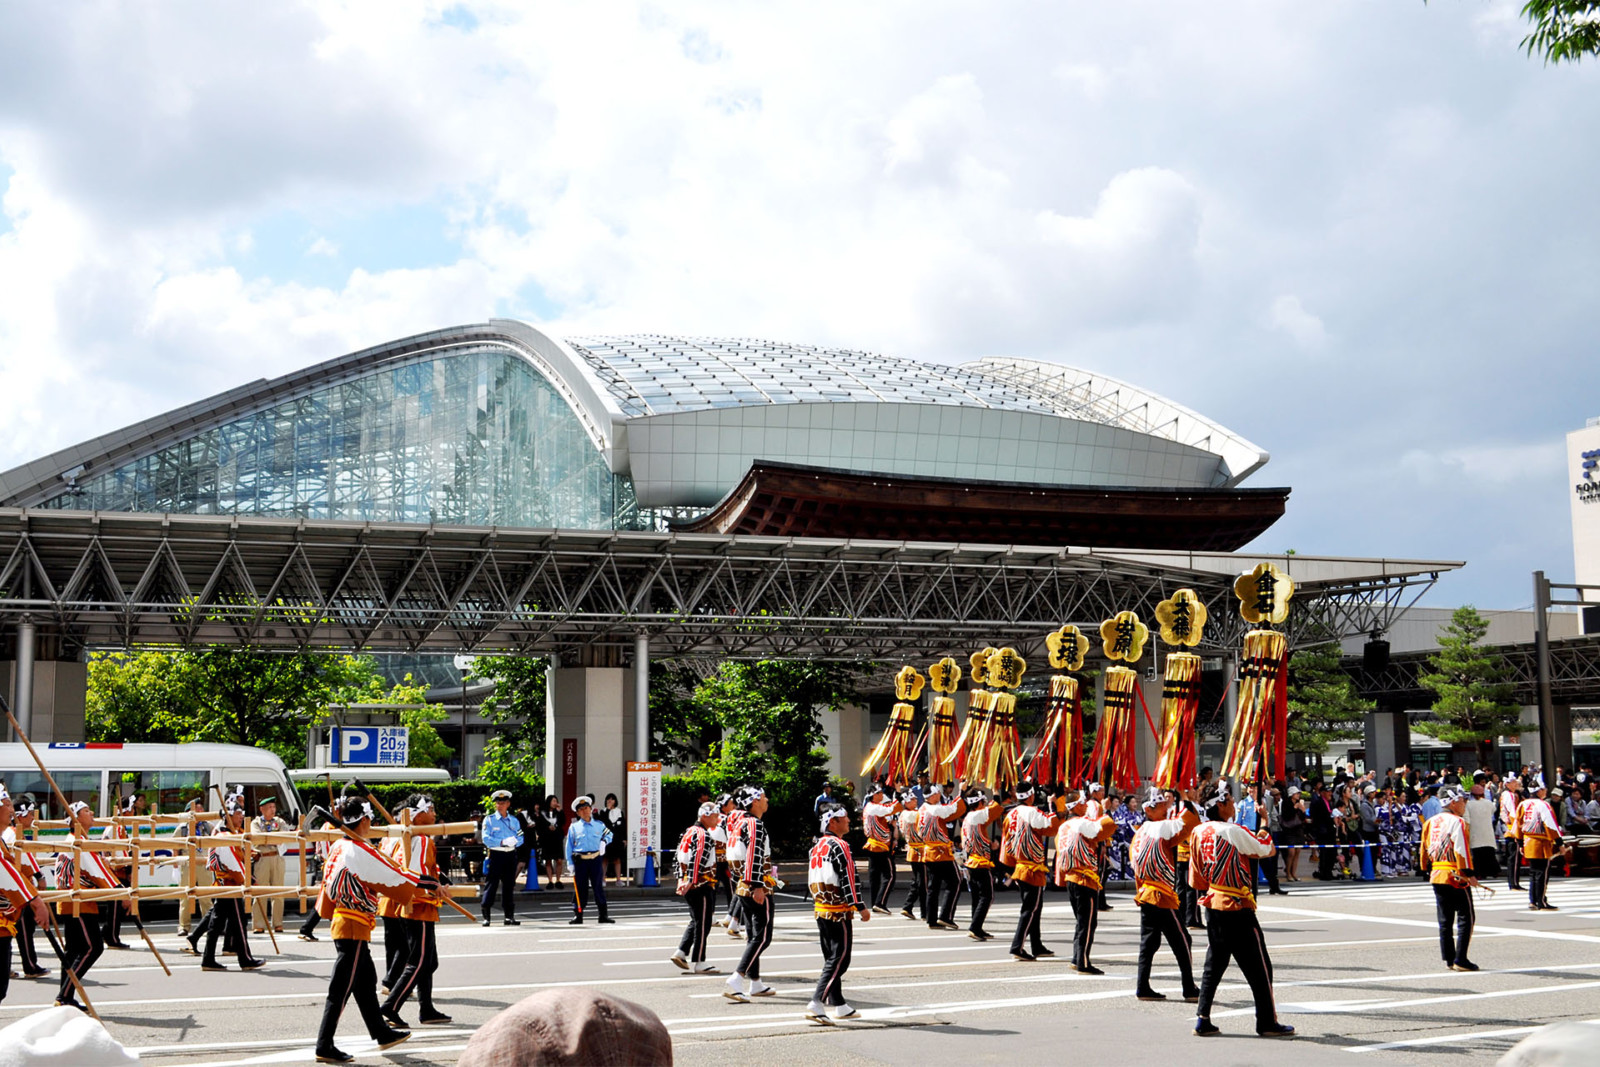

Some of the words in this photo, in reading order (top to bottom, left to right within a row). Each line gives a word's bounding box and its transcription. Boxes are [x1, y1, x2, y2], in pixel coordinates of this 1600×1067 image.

[1252, 570, 1280, 614] 金石
[1056, 632, 1078, 664] 二塚
[1112, 620, 1136, 654] 安原
[342, 730, 370, 762] P
[380, 737, 406, 751] 20分
[381, 728, 406, 737] 入庫後
[380, 751, 405, 764] 無料
